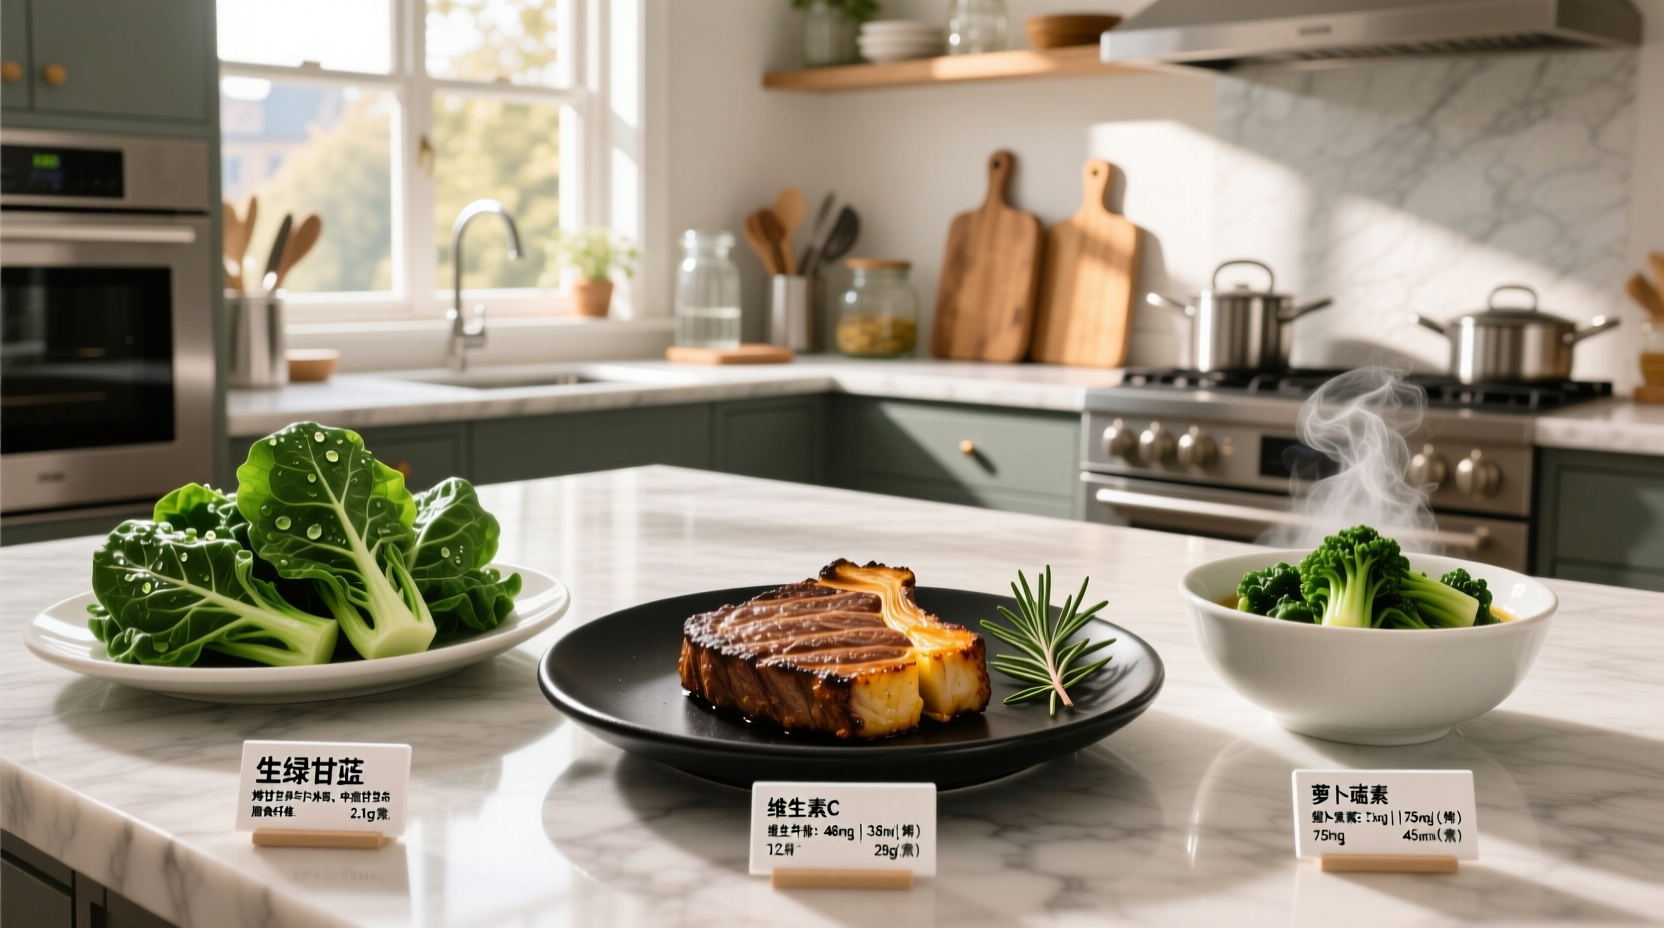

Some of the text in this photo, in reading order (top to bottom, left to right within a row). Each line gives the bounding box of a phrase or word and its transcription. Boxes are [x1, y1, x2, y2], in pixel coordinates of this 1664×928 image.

[256, 756, 364, 785] 生绿甘蓝
[767, 797, 840, 818] 维生素C
